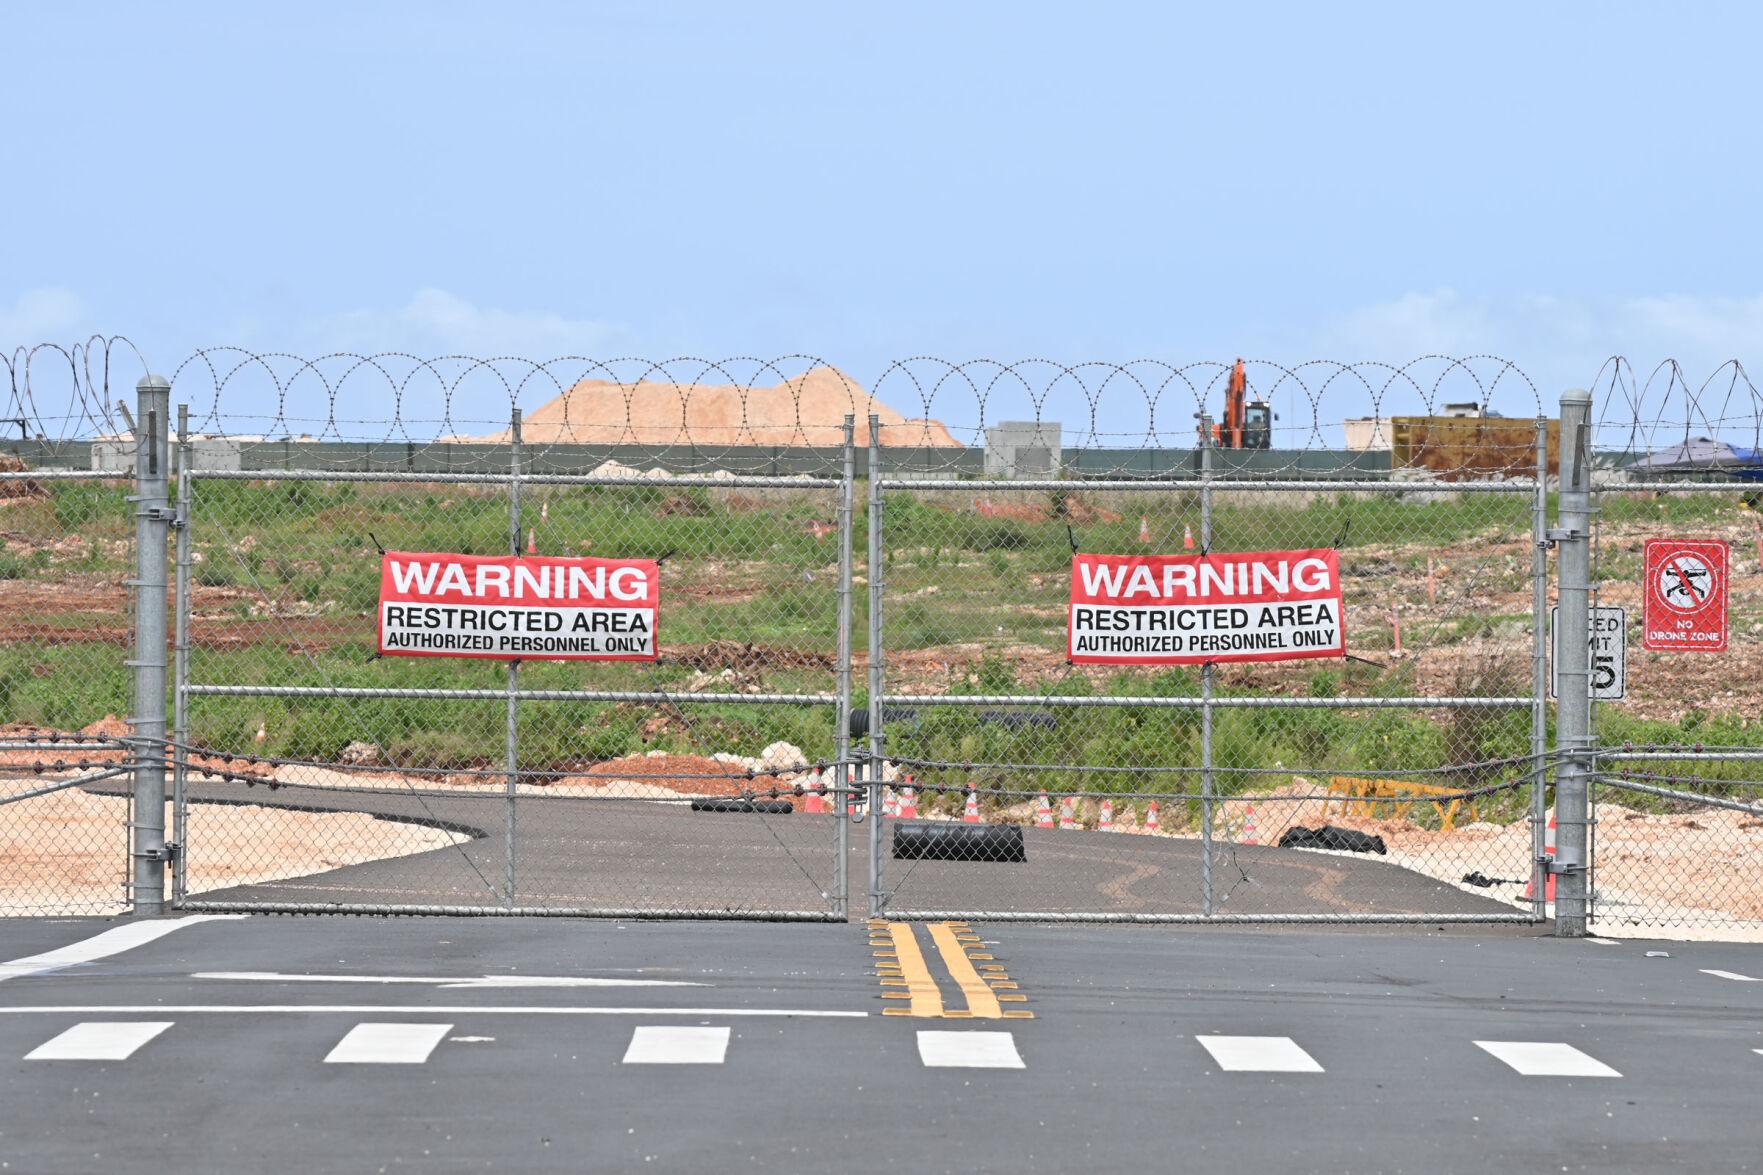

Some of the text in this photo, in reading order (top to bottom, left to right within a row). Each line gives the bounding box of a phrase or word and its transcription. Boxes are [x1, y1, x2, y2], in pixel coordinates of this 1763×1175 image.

[390, 561, 648, 600] WARNING
[1080, 558, 1330, 598] WARNING
[386, 606, 648, 633] RESTRICTED AREA
[1076, 604, 1334, 631] RESTRICTED AREA
[1676, 620, 1693, 629] NO
[387, 632, 647, 652] AUTHORIZED PERSONNEL ONLY
[1076, 629, 1334, 652] AUTHORIZED PERSONNEL ONLY
[1650, 631, 1720, 641] DRONE ZONE
